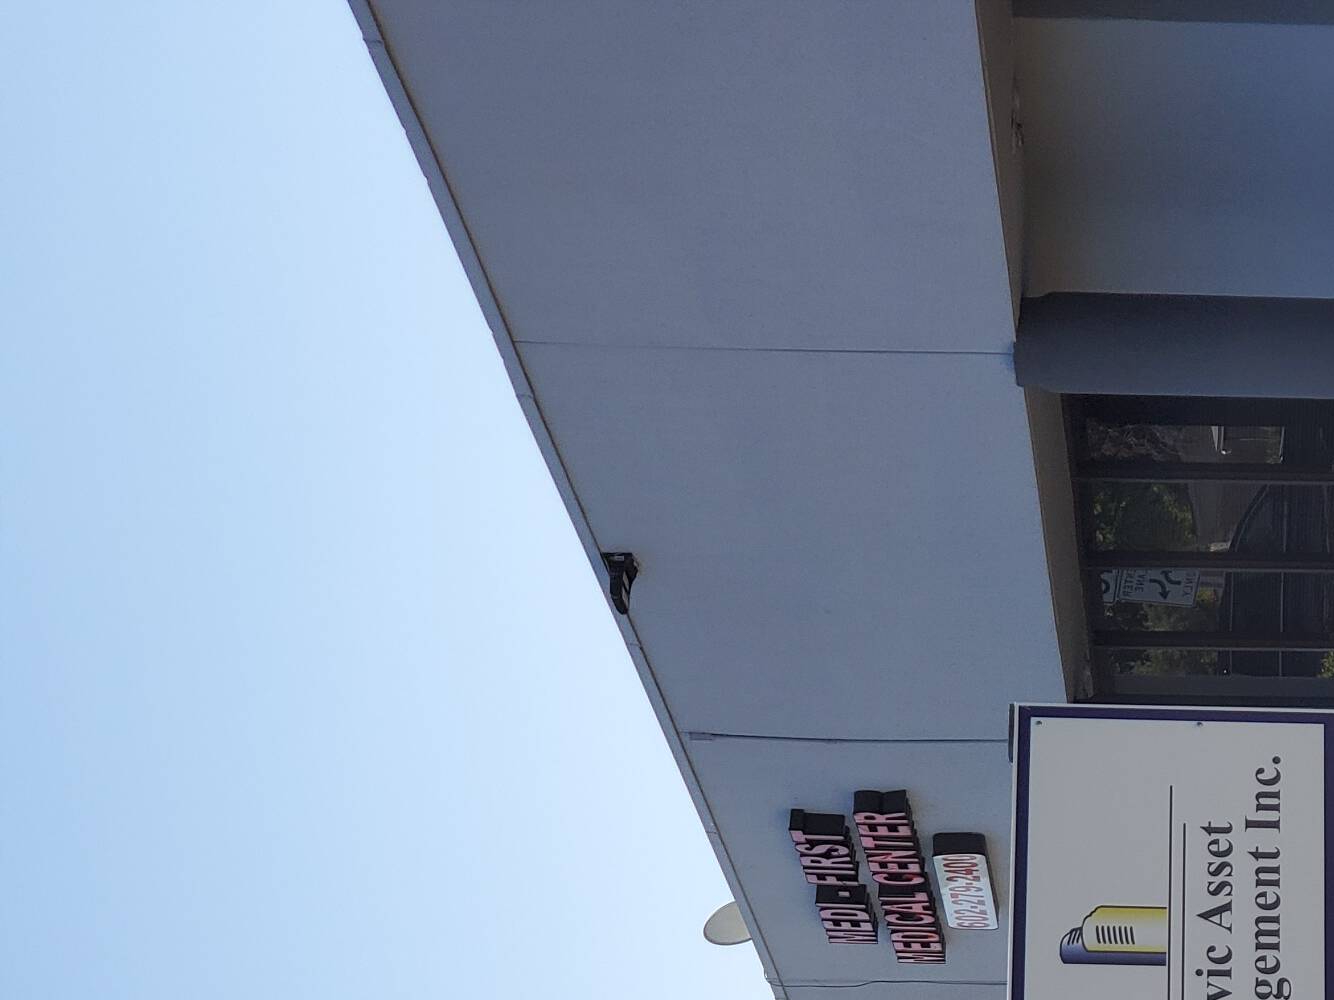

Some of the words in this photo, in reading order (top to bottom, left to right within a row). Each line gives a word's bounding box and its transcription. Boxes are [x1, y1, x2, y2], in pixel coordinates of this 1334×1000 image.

[1245, 756, 1281, 833] Inc.
[789, 830, 857, 885] FIRST
[855, 812, 924, 885] CENTER
[1196, 821, 1233, 934] Asset
[815, 903, 878, 944] MEDI
[879, 892, 944, 963] MEDICAL
[943, 854, 989, 928] 602-279-2400
